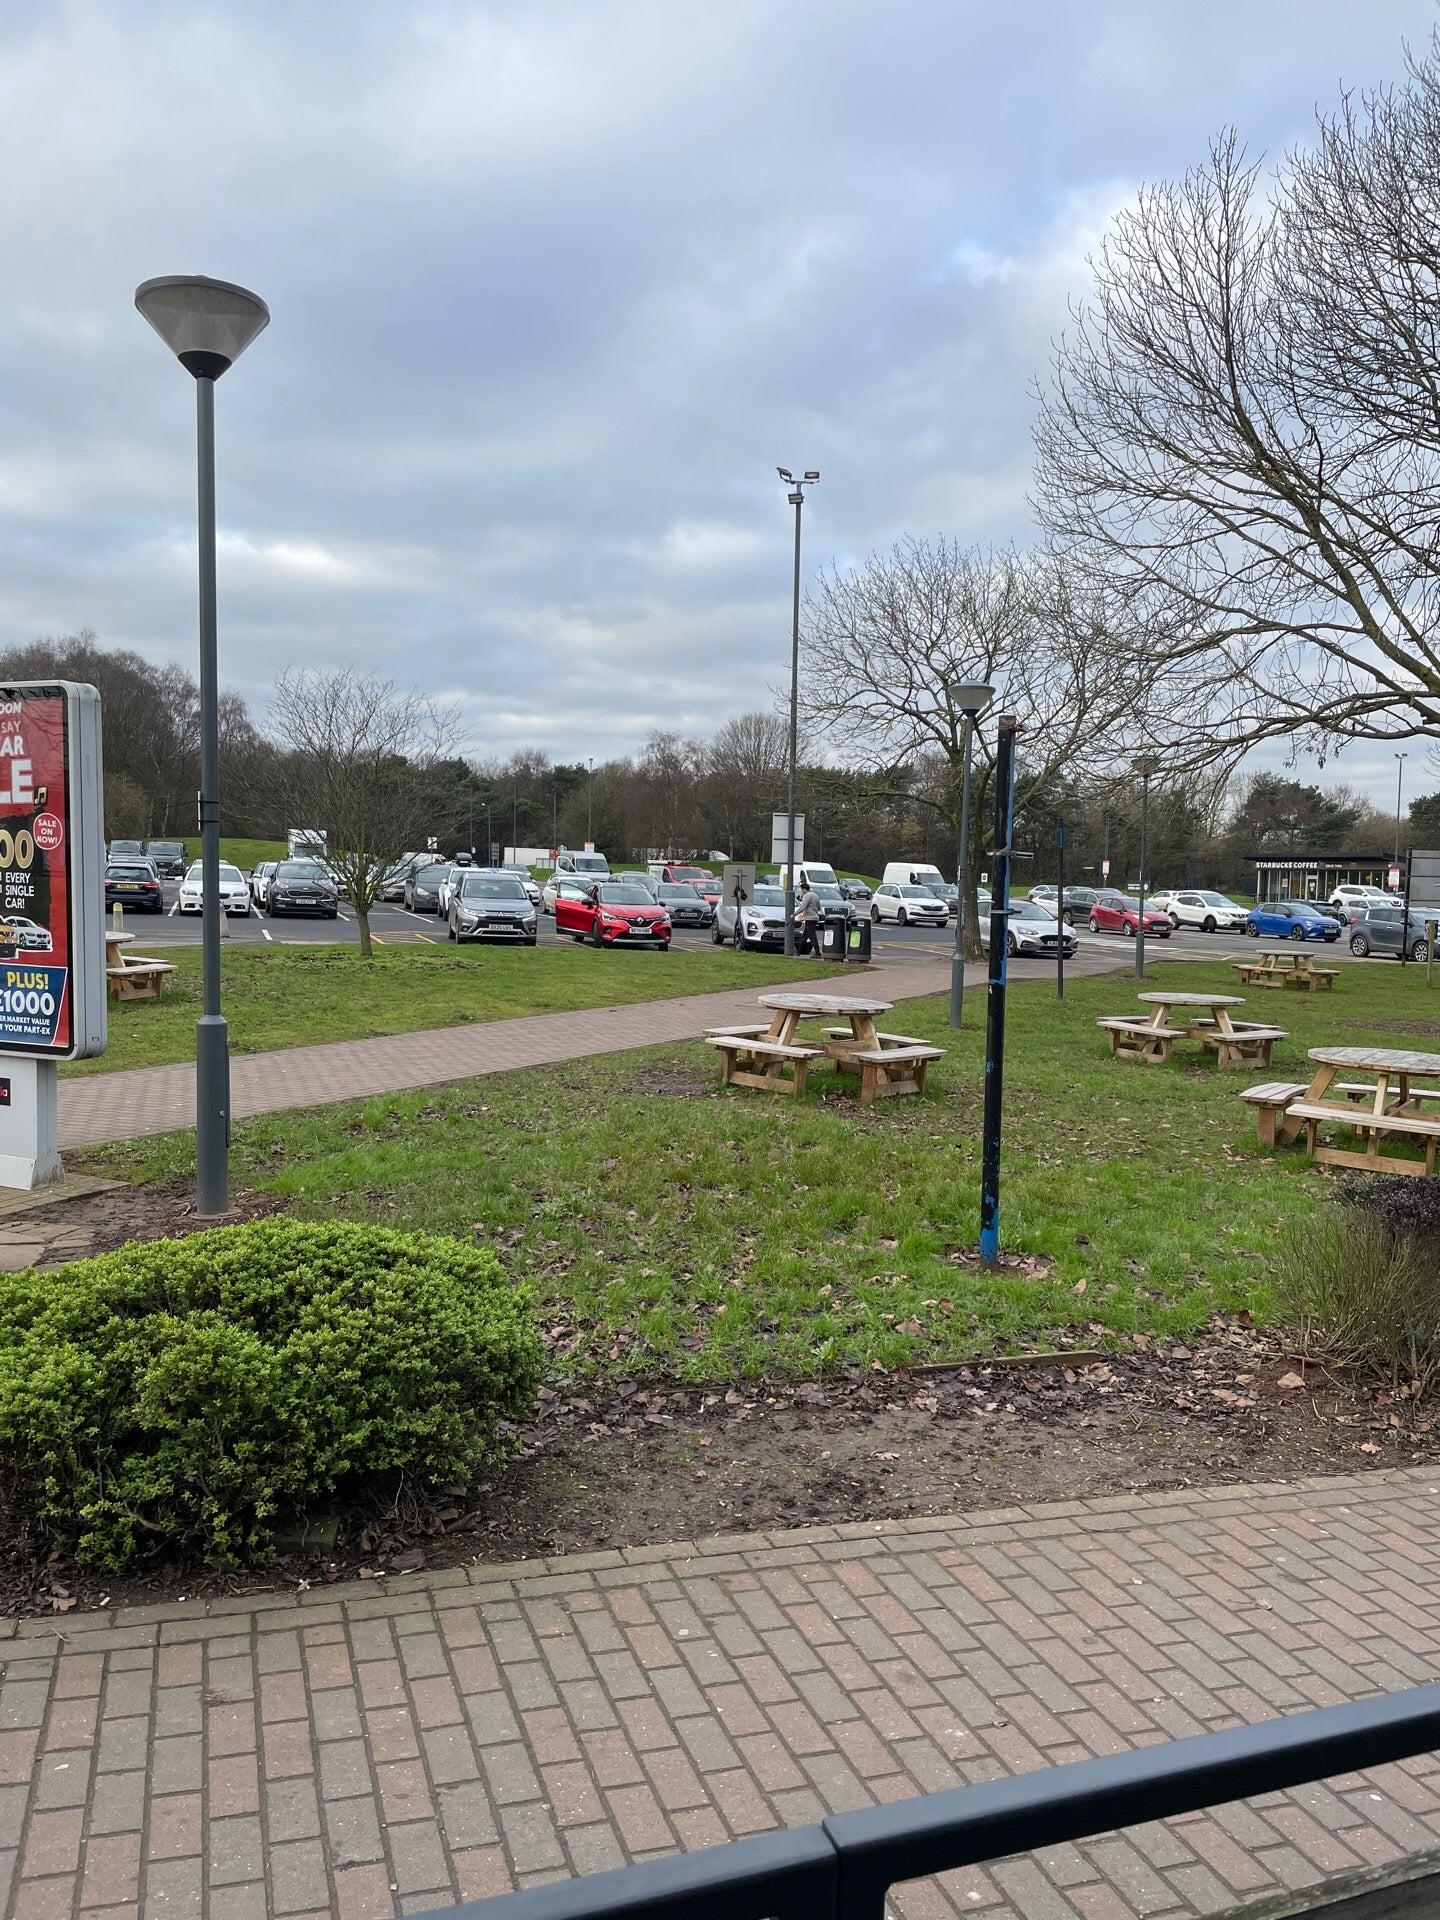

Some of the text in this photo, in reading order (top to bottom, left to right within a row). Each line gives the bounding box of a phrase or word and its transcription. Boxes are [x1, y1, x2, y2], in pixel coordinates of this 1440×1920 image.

[1, 720, 21, 734] SAY
[38, 819, 57, 827] SALE
[40, 827, 53, 835] ON
[36, 836, 58, 844] NOW!
[1293, 861, 1318, 869] COFFEE
[5, 871, 31, 884] EVERY
[5, 884, 35, 897] SINGLE
[5, 897, 25, 909] CAR!
[6, 971, 49, 990] PLUS!
[6, 1015, 31, 1024] MARKET
[31, 1017, 51, 1026] VALUE
[4, 1023, 23, 1033] YOUR
[23, 1025, 51, 1035] PART-EX
